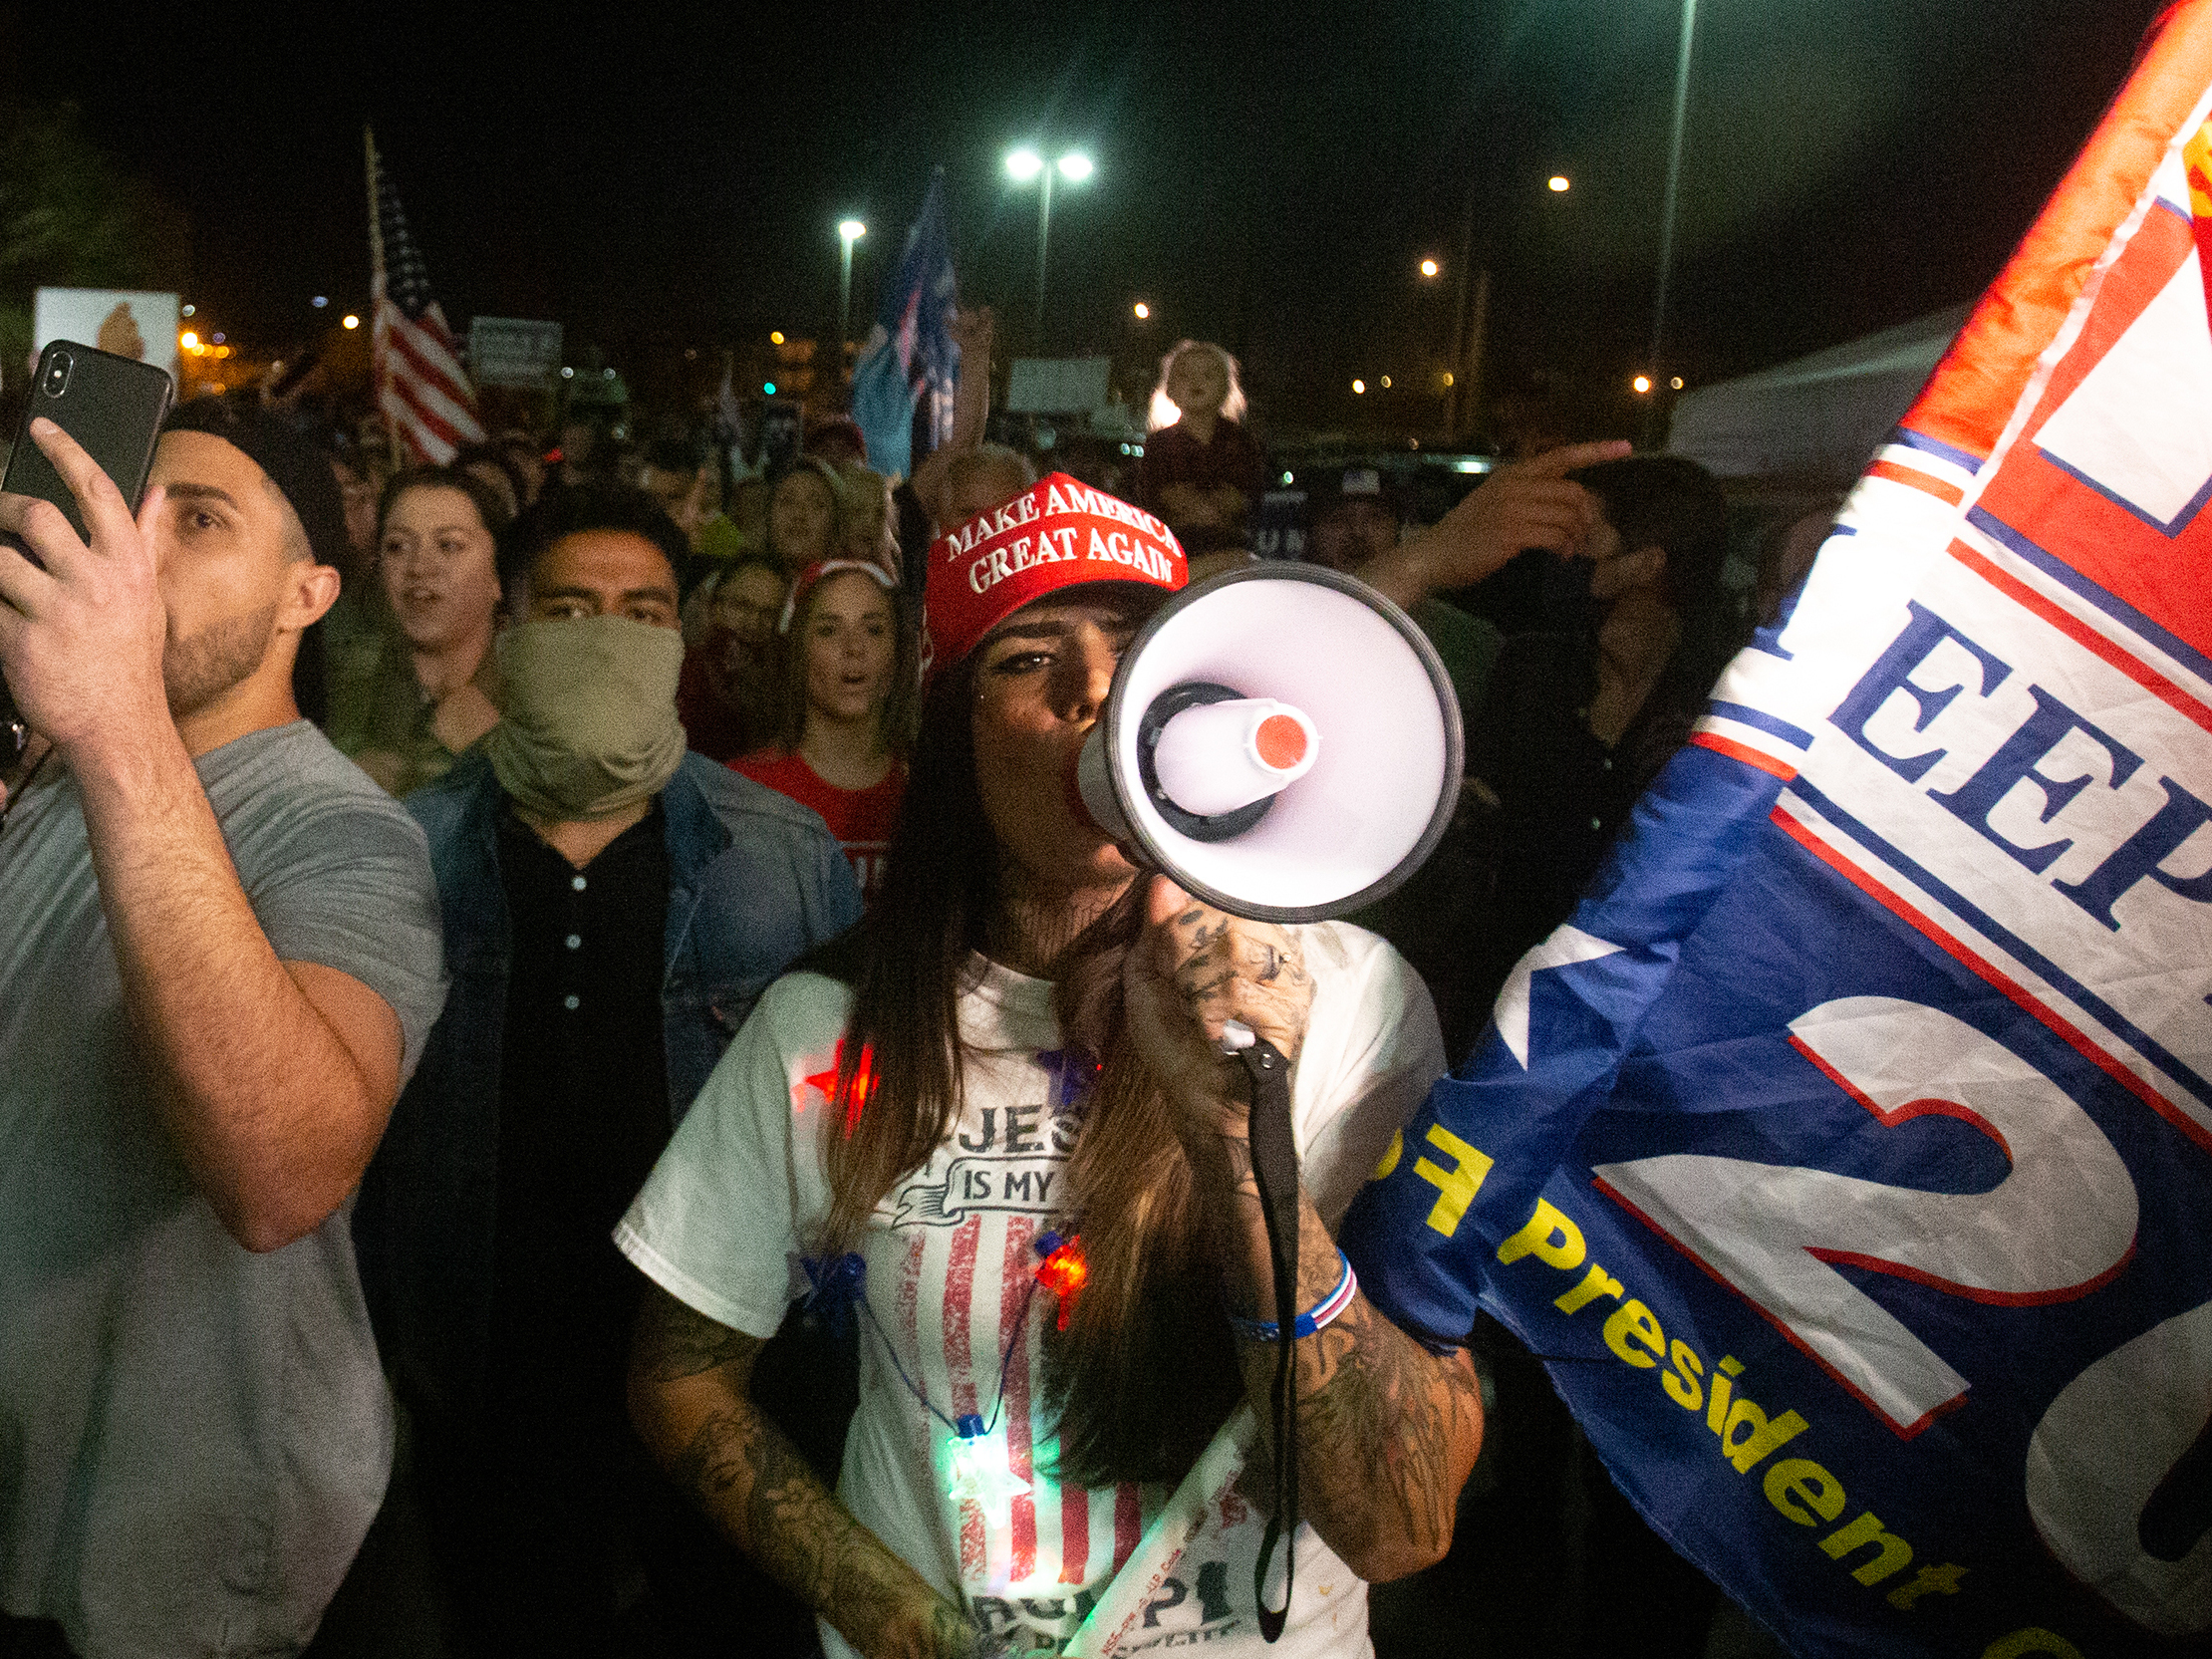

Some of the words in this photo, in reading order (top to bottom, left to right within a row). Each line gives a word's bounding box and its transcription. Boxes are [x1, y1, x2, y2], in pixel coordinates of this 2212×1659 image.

[947, 492, 1040, 562] MAKE
[1045, 484, 1183, 558] AMERICA
[968, 527, 1077, 594] GREAT
[1086, 527, 1173, 583] AGAIN
[1746, 523, 2212, 933] EEP
[963, 1170, 992, 1201] IS
[1003, 1170, 1055, 1203] MY
[1497, 1197, 1972, 1610] President
